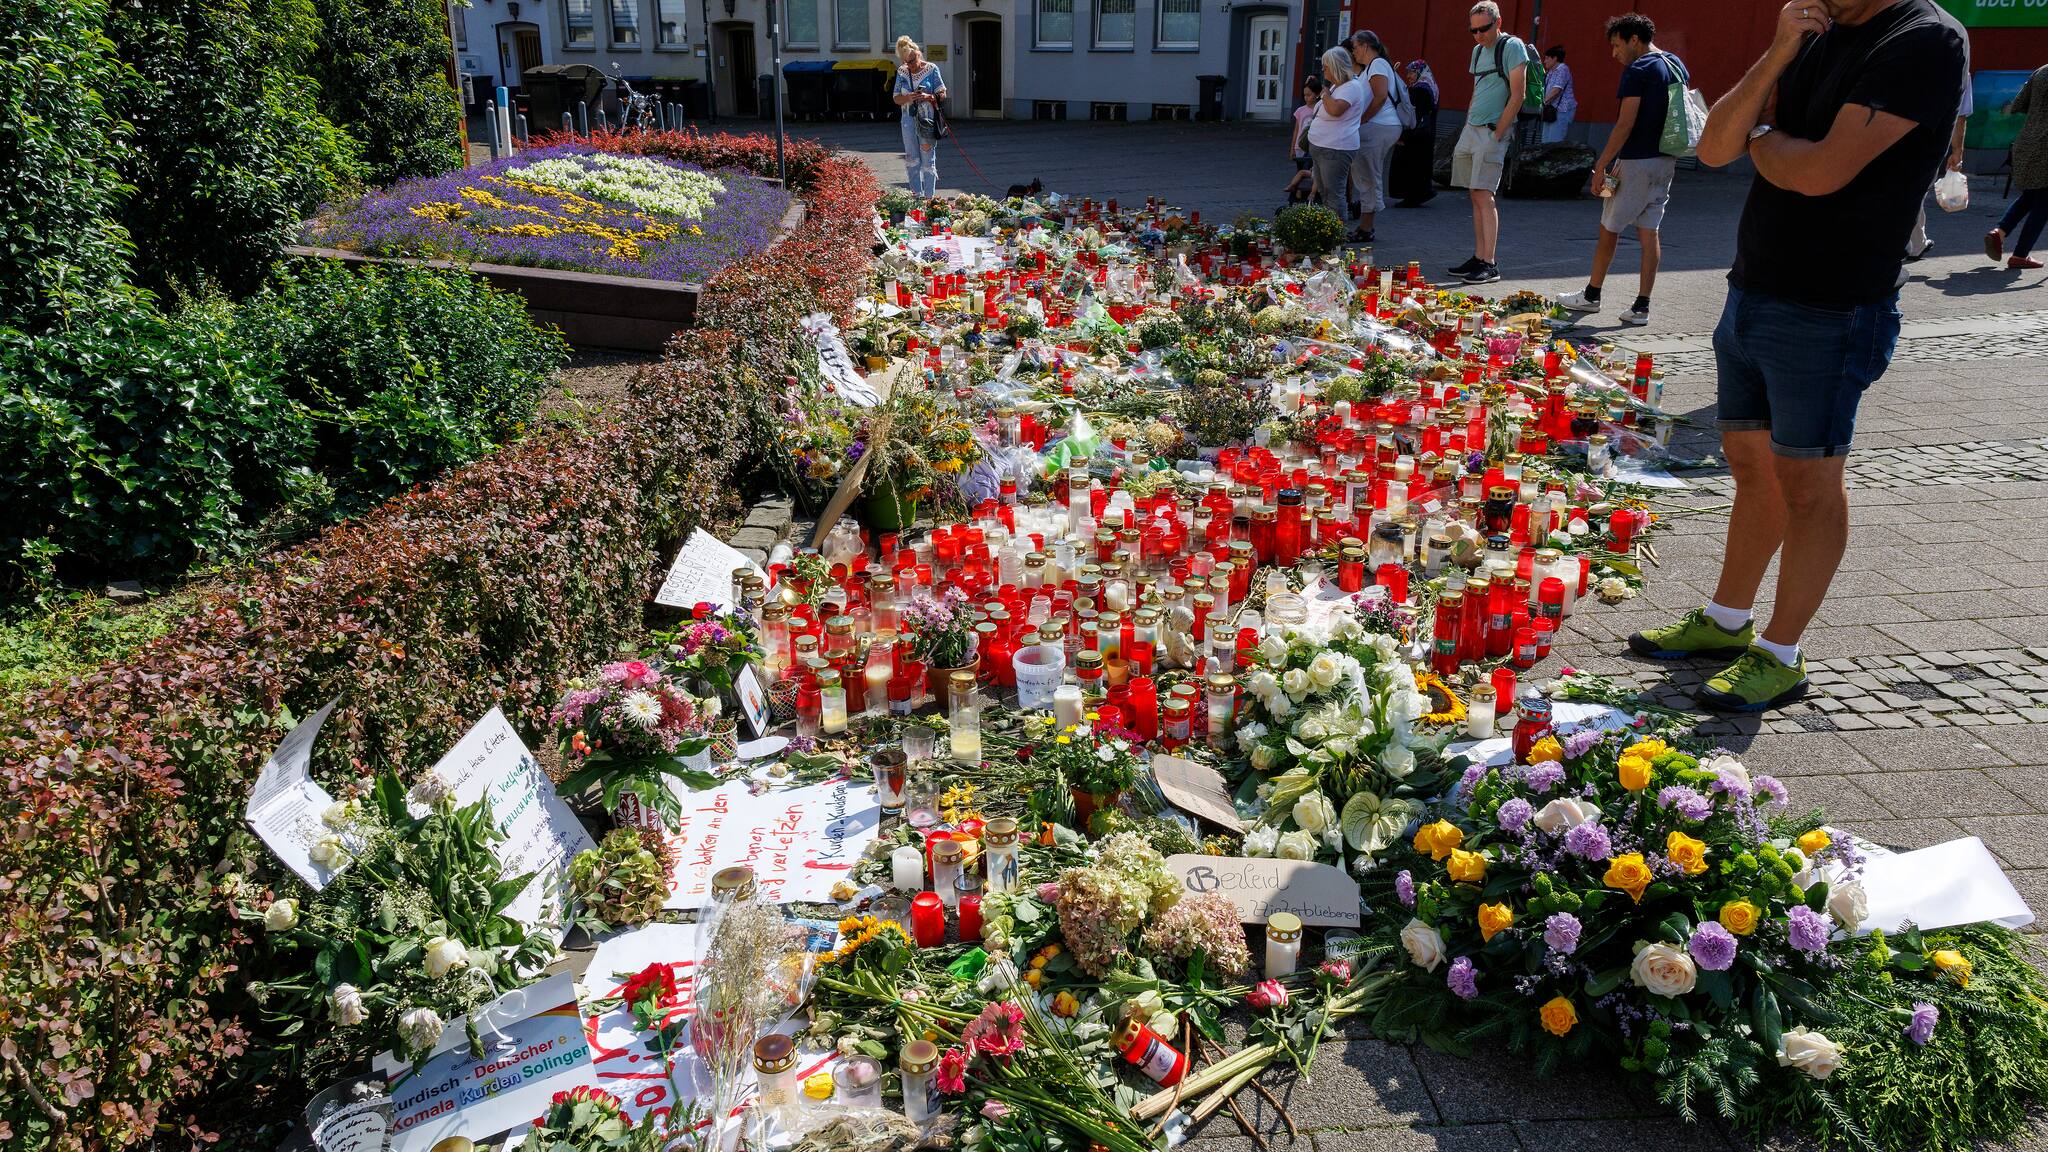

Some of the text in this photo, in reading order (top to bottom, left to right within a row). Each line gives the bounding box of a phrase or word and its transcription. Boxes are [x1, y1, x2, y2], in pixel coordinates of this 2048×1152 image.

[453, 768, 473, 791] ewalt,
[696, 793, 729, 814] den
[817, 827, 846, 860] Kurden
[459, 1072, 522, 1106] Kurden
